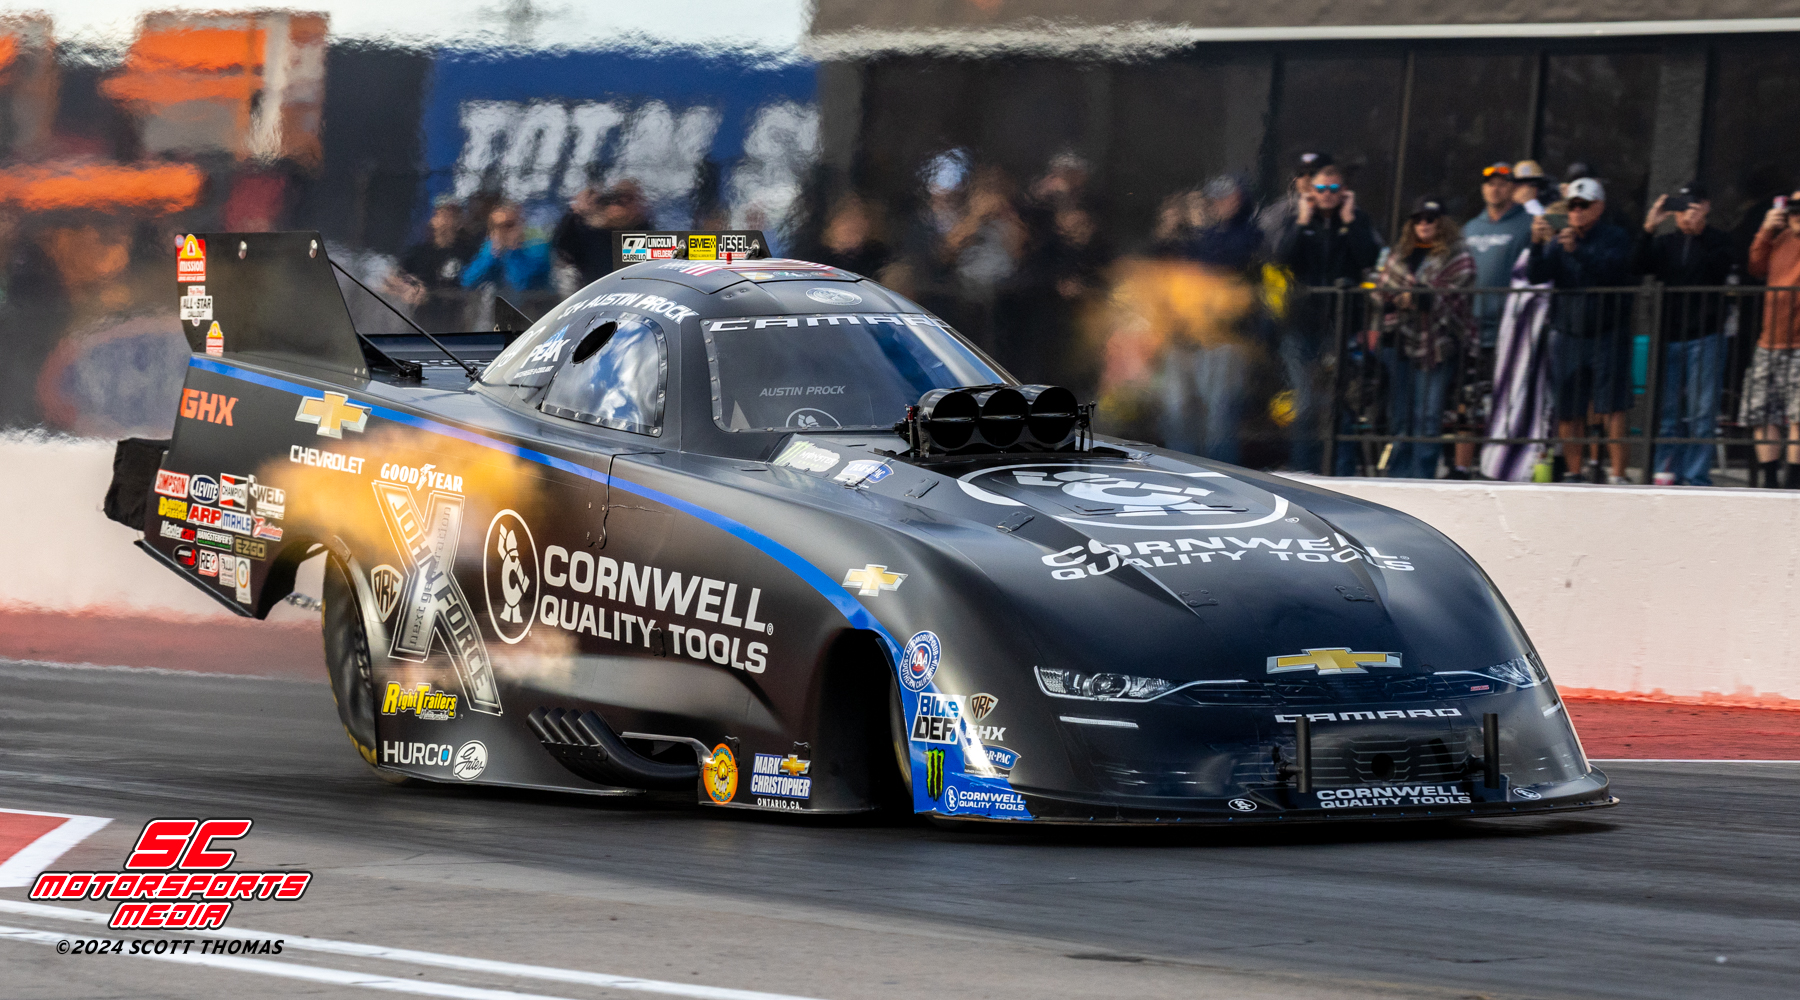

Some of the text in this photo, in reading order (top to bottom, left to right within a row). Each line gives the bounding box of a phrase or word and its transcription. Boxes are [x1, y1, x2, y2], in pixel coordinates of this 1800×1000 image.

[648, 238, 672, 248] LINCOLN
[719, 236, 747, 252] JESEL
[583, 292, 644, 310] AUSTIN
[634, 294, 700, 325] PROCK
[521, 338, 571, 368] PEAK
[760, 386, 845, 397] AUSTIN PROCK
[180, 388, 237, 427] GHX
[289, 444, 366, 475] CHEVROLET
[157, 473, 187, 495] SIMPSON
[222, 485, 247, 499] CHAMPION
[257, 485, 285, 506] WELD
[189, 505, 222, 524] ARP
[223, 513, 251, 531] MAHLE
[1051, 548, 1414, 581] QUALITY TOOLS
[409, 506, 451, 646] next geeration
[392, 501, 443, 585] JOHN
[434, 584, 488, 692] FORCE
[540, 595, 769, 674] QUALITY TOOLS
[912, 652, 928, 667] AAA
[919, 696, 959, 718] Blue
[1275, 708, 1462, 723] CAMARO
[914, 717, 957, 741] DEF
[383, 741, 453, 766] HURCO
[454, 747, 485, 775] Gates
[753, 756, 781, 774] MARK
[752, 775, 810, 797] CHRISTOPHER
[1316, 786, 1467, 801] CORNWELL
[959, 800, 1025, 811] QUALITY TOOLS
[960, 791, 1024, 804] CORNWELL
[1320, 796, 1471, 809] QUALITY TOOLS
